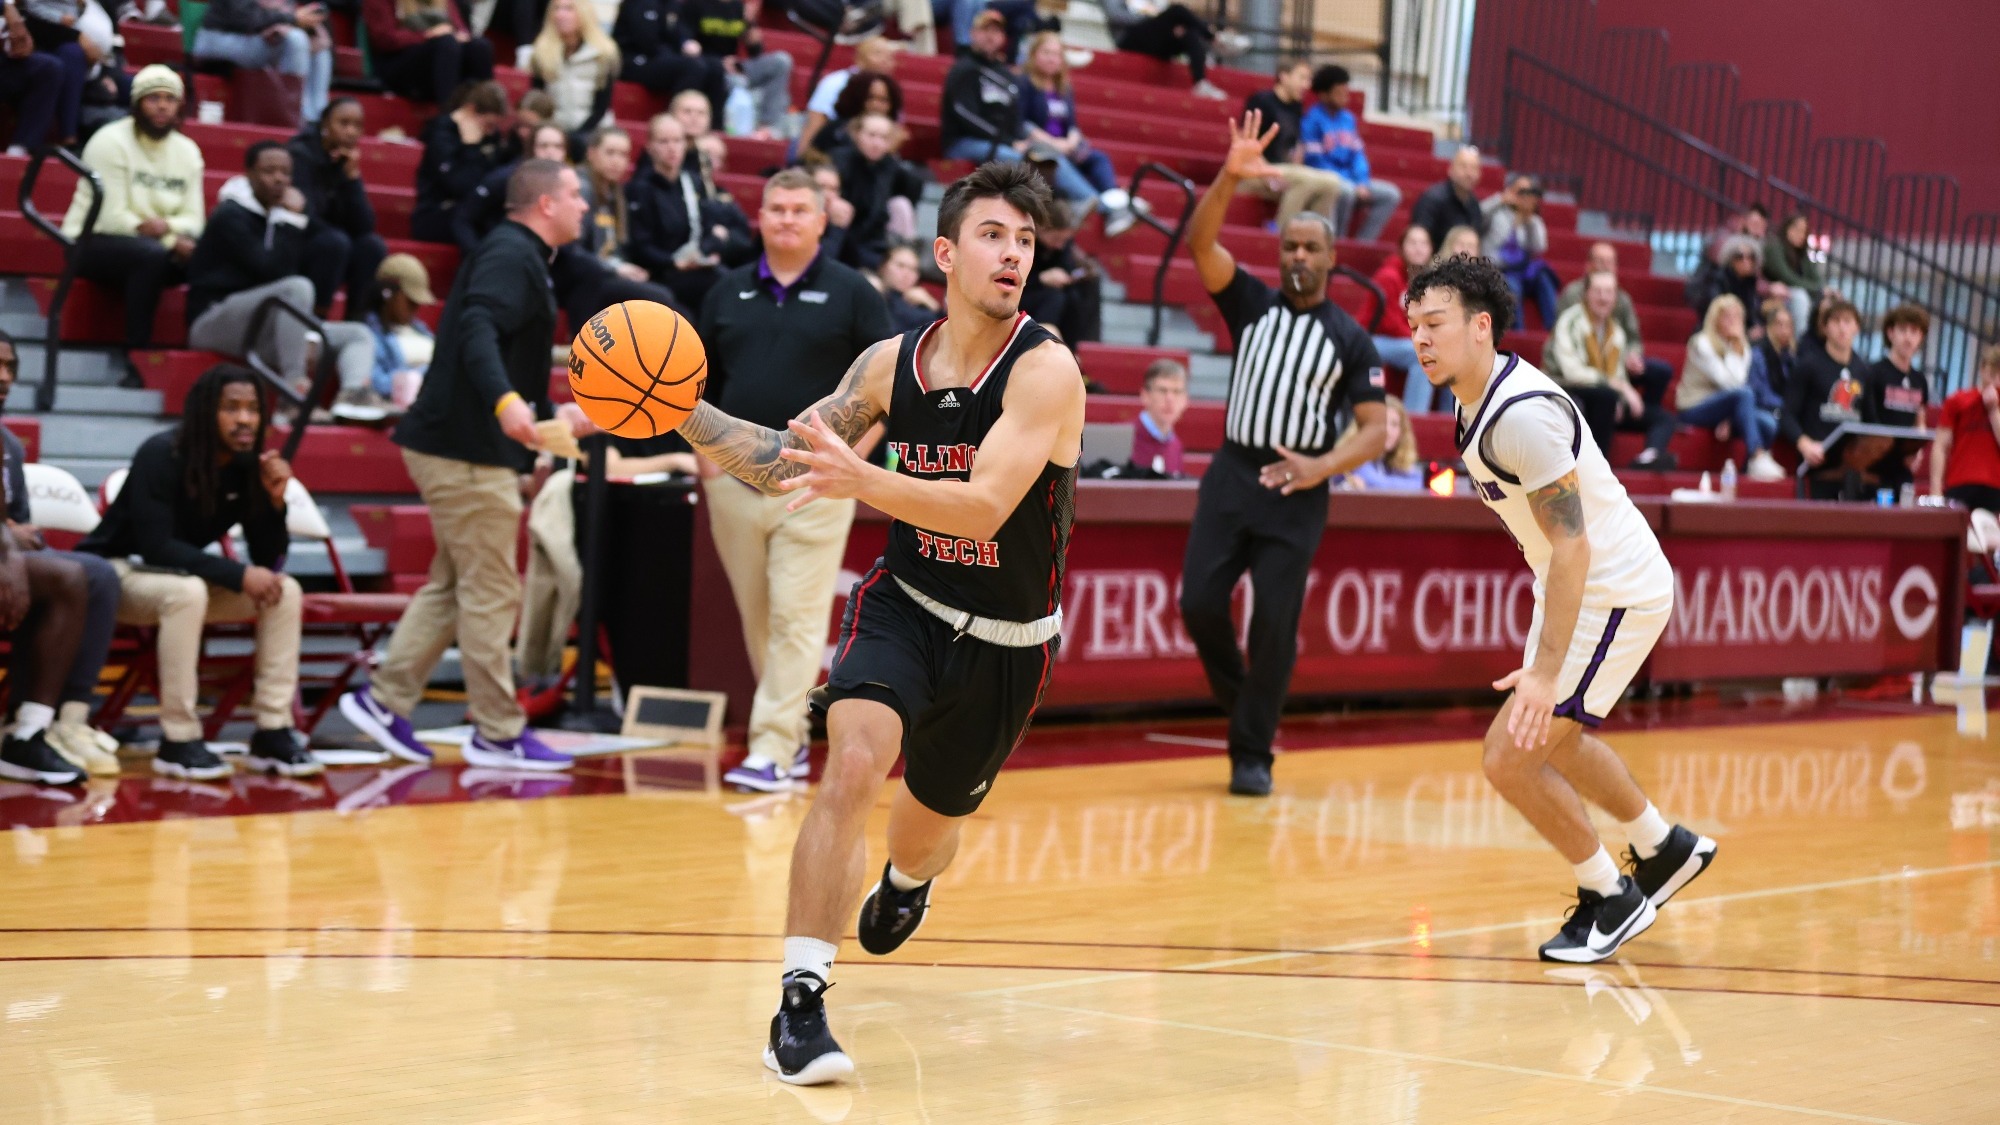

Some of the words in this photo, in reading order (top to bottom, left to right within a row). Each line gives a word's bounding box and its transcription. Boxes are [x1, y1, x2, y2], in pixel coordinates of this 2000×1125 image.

[938, 400, 961, 409] adidas
[915, 528, 1000, 568] TECH
[1326, 567, 1403, 655] OF
[1411, 567, 1536, 654] CHIC
[1663, 565, 1883, 646] MAROONS
